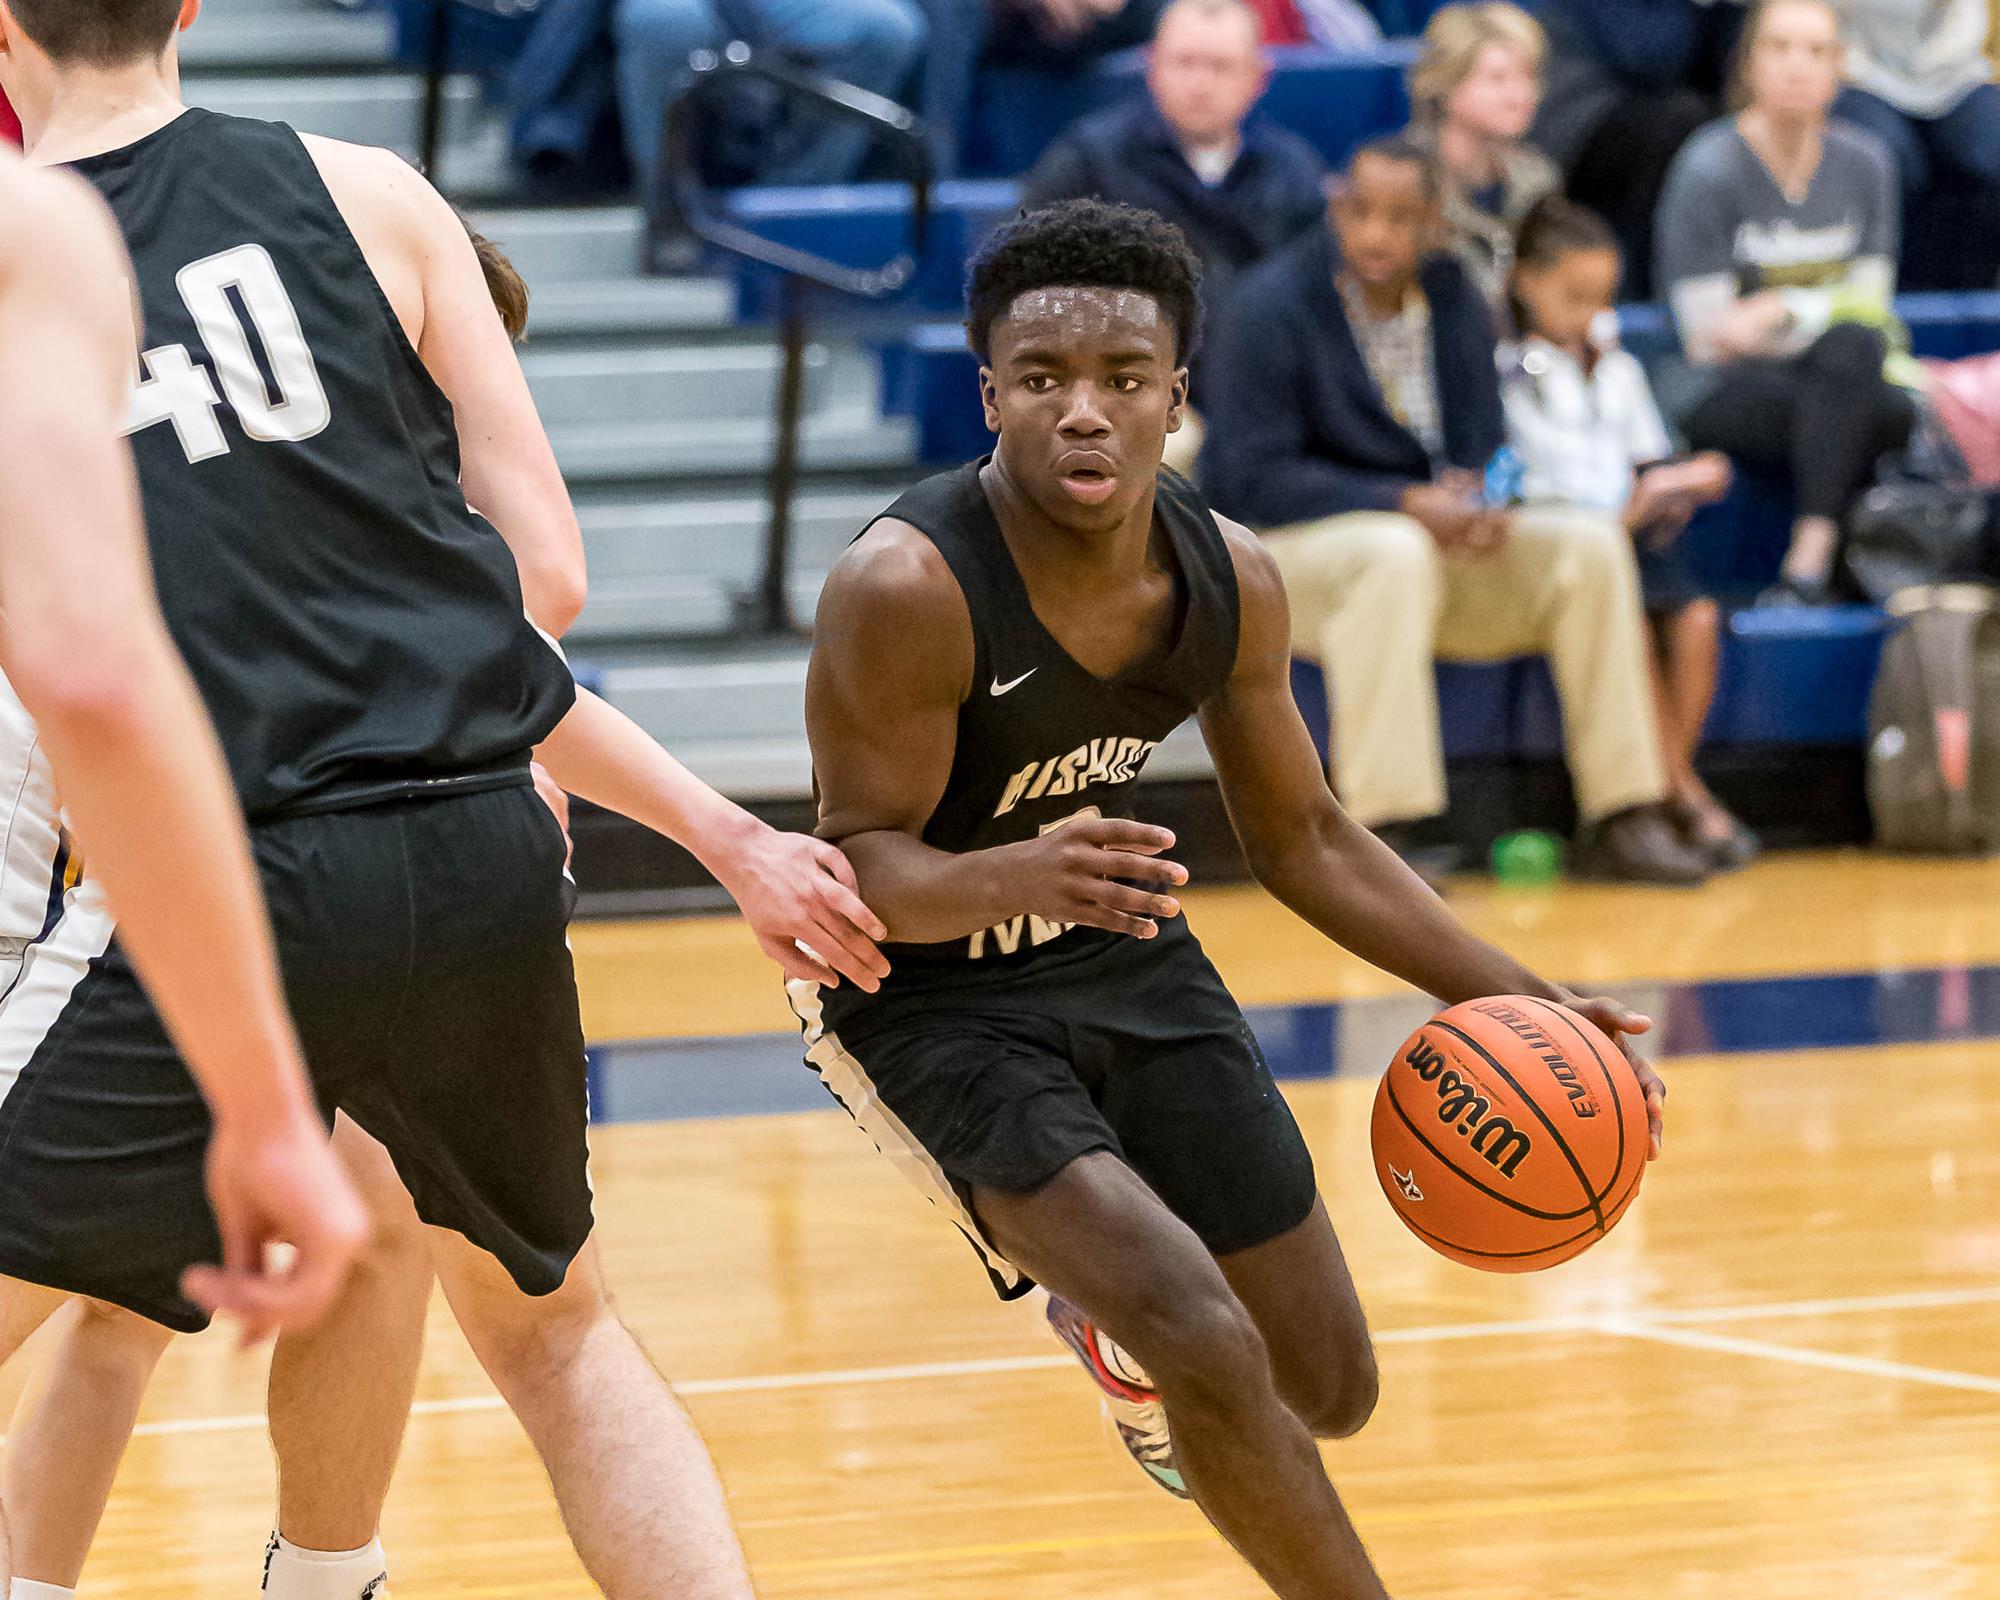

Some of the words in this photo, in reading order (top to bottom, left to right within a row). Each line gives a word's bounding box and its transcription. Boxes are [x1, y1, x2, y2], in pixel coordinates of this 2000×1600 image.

[118, 242, 332, 465] 40
[1404, 1033, 1532, 1182] Wilson
[1470, 1002, 1597, 1118] EVOLUTION
